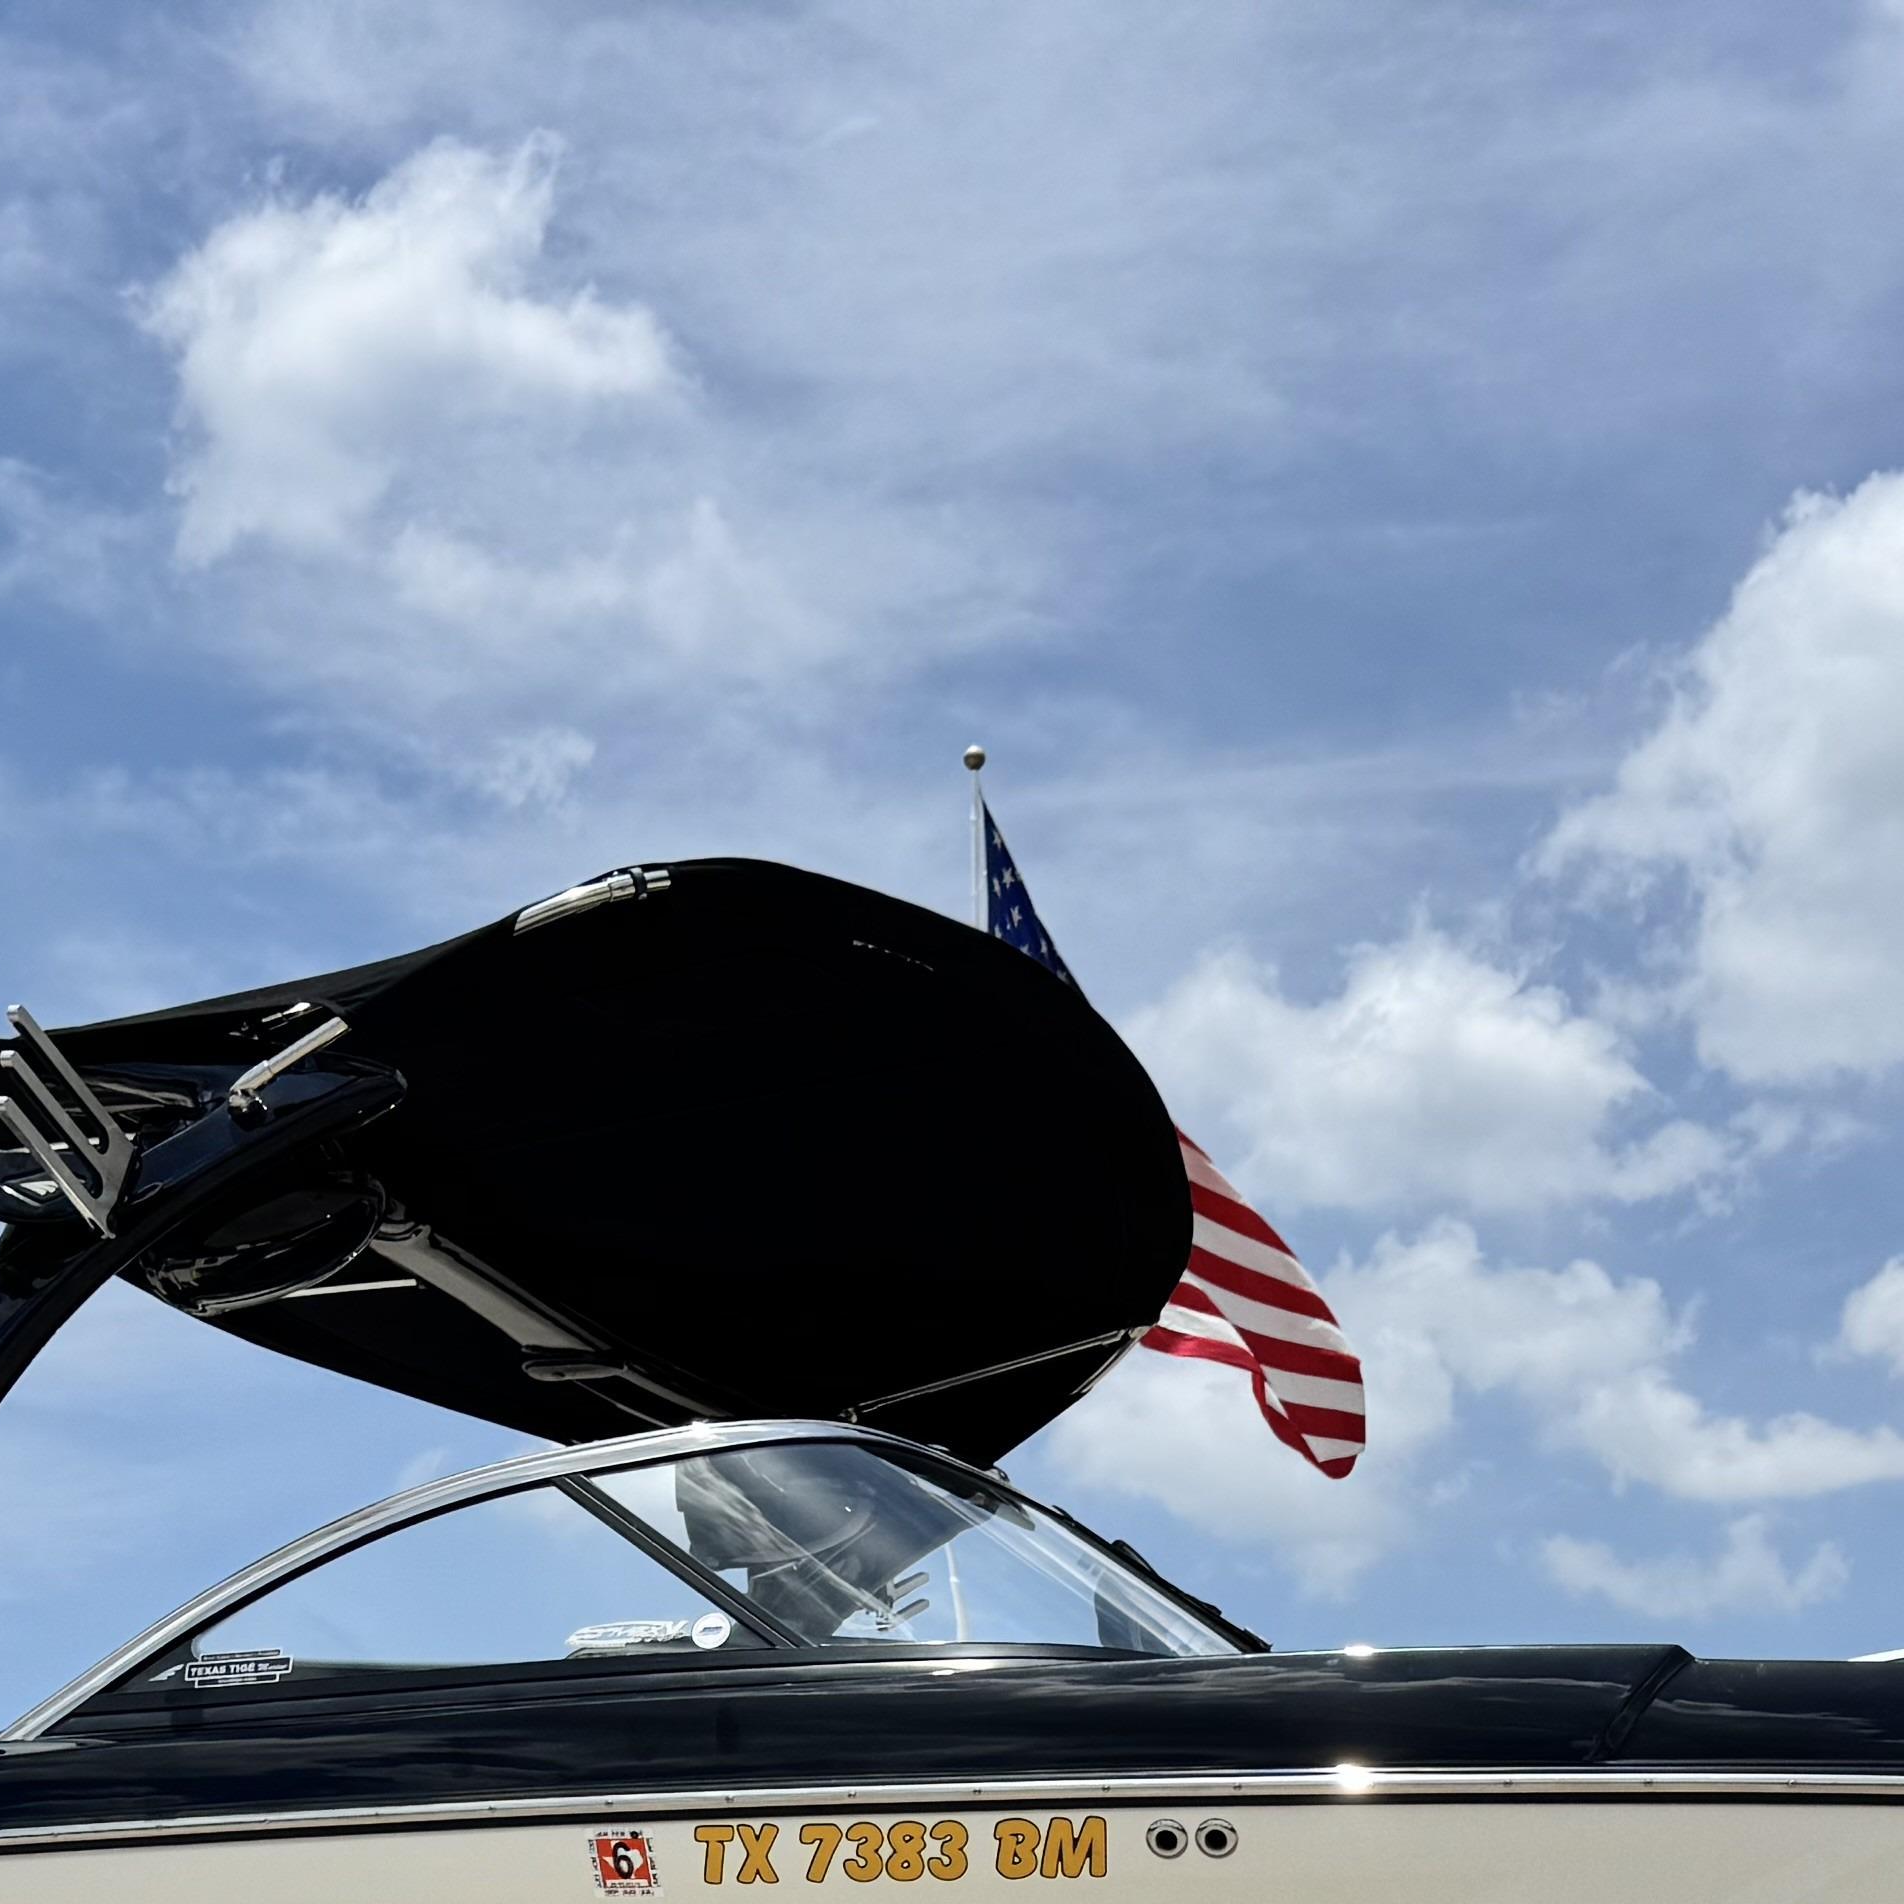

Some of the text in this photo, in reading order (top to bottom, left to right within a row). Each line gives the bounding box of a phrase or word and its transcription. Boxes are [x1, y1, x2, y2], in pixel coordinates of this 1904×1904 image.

[190, 1664, 227, 1677] TEXAS
[693, 1823, 780, 1885] TX
[799, 1819, 969, 1883] 7383
[993, 1815, 1108, 1880] BM
